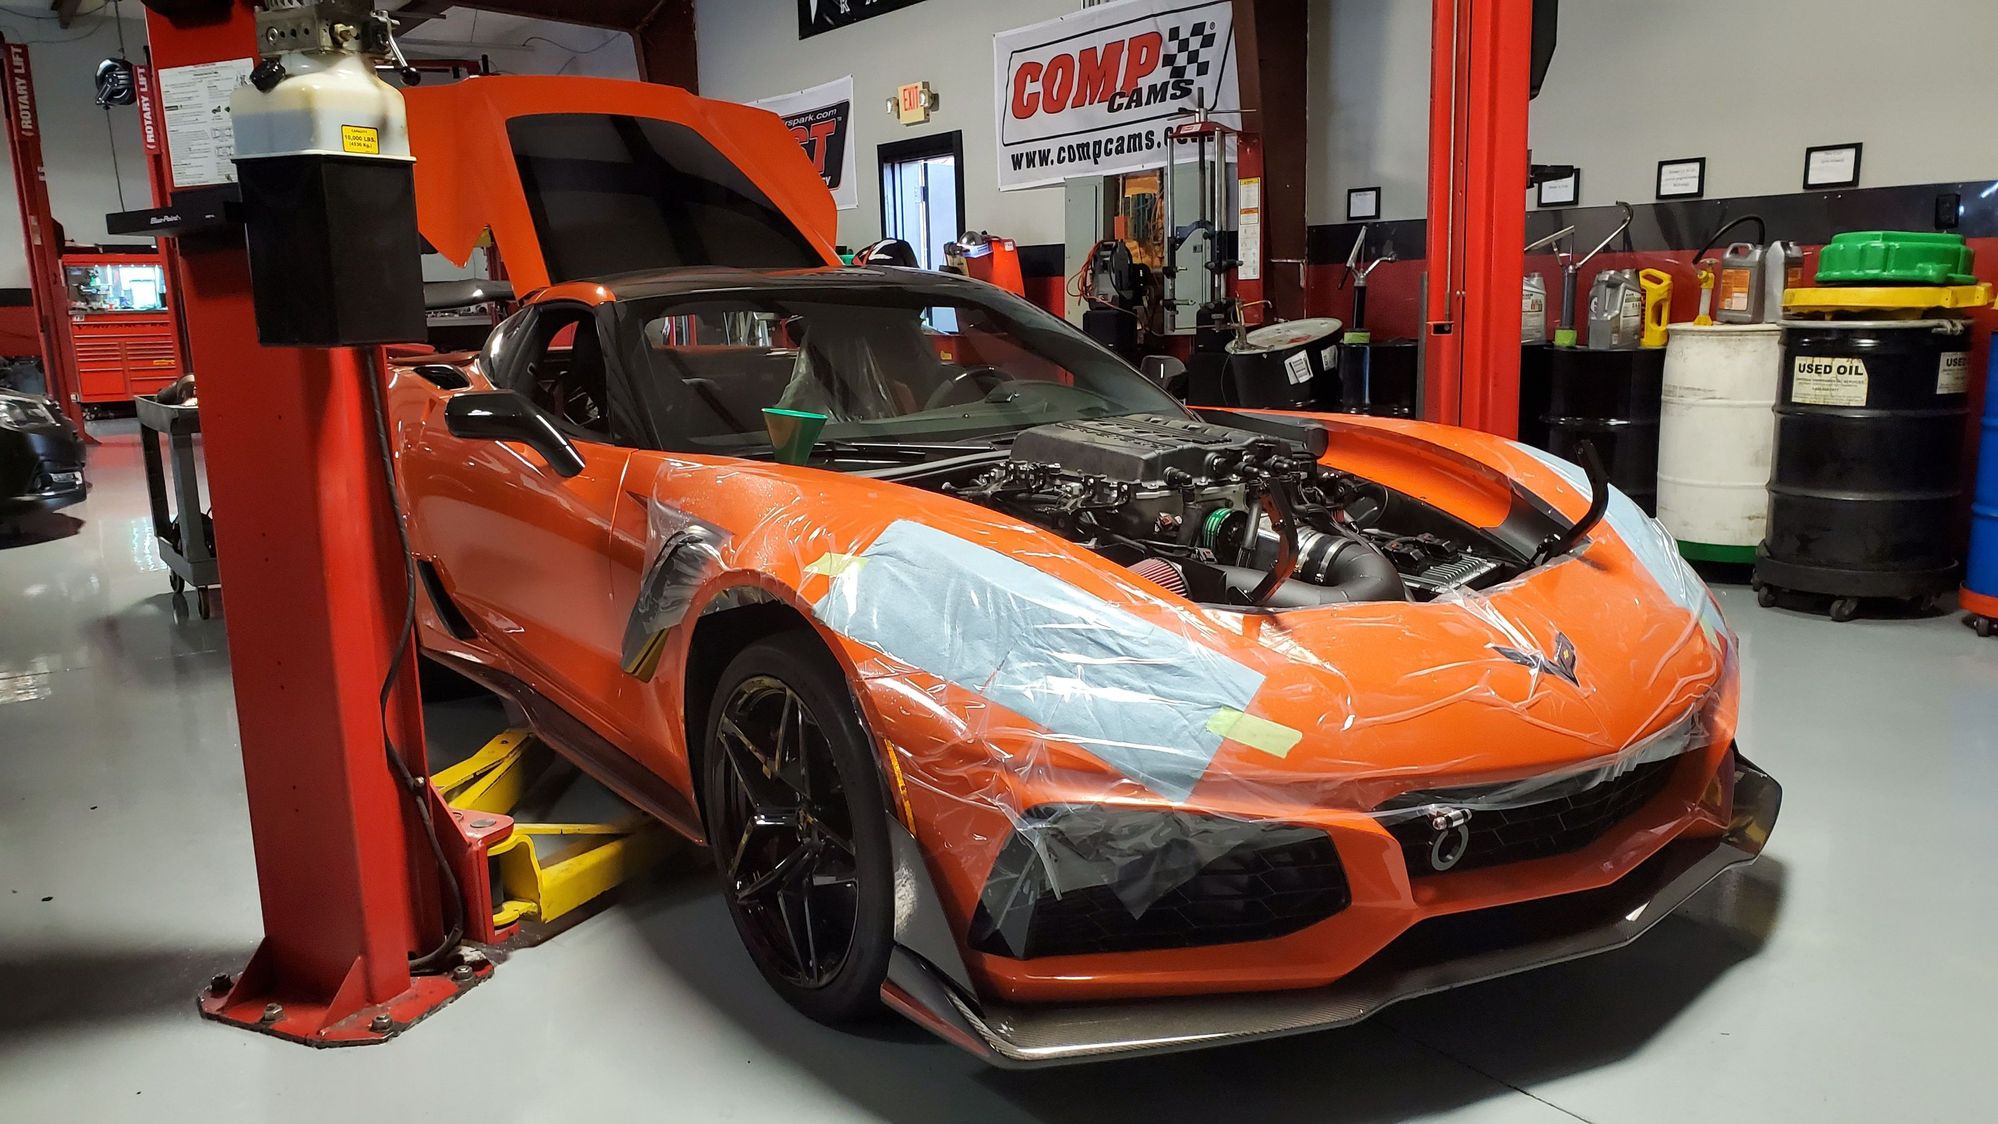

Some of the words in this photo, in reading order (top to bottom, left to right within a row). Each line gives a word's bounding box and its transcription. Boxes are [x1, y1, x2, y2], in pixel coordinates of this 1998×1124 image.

[11, 46, 26, 74] LIFT
[1011, 31, 1162, 119] COMP
[136, 67, 148, 92] LIFT
[15, 78, 33, 129] ROTARY
[903, 86, 919, 111] EXIT
[1107, 79, 1194, 113] CAMS
[140, 95, 155, 143] ROTARY
[784, 108, 837, 127] rspark.com
[1011, 126, 1215, 171] www.compcams.c
[1798, 363, 1833, 375] USED
[1836, 364, 1864, 376] OIL
